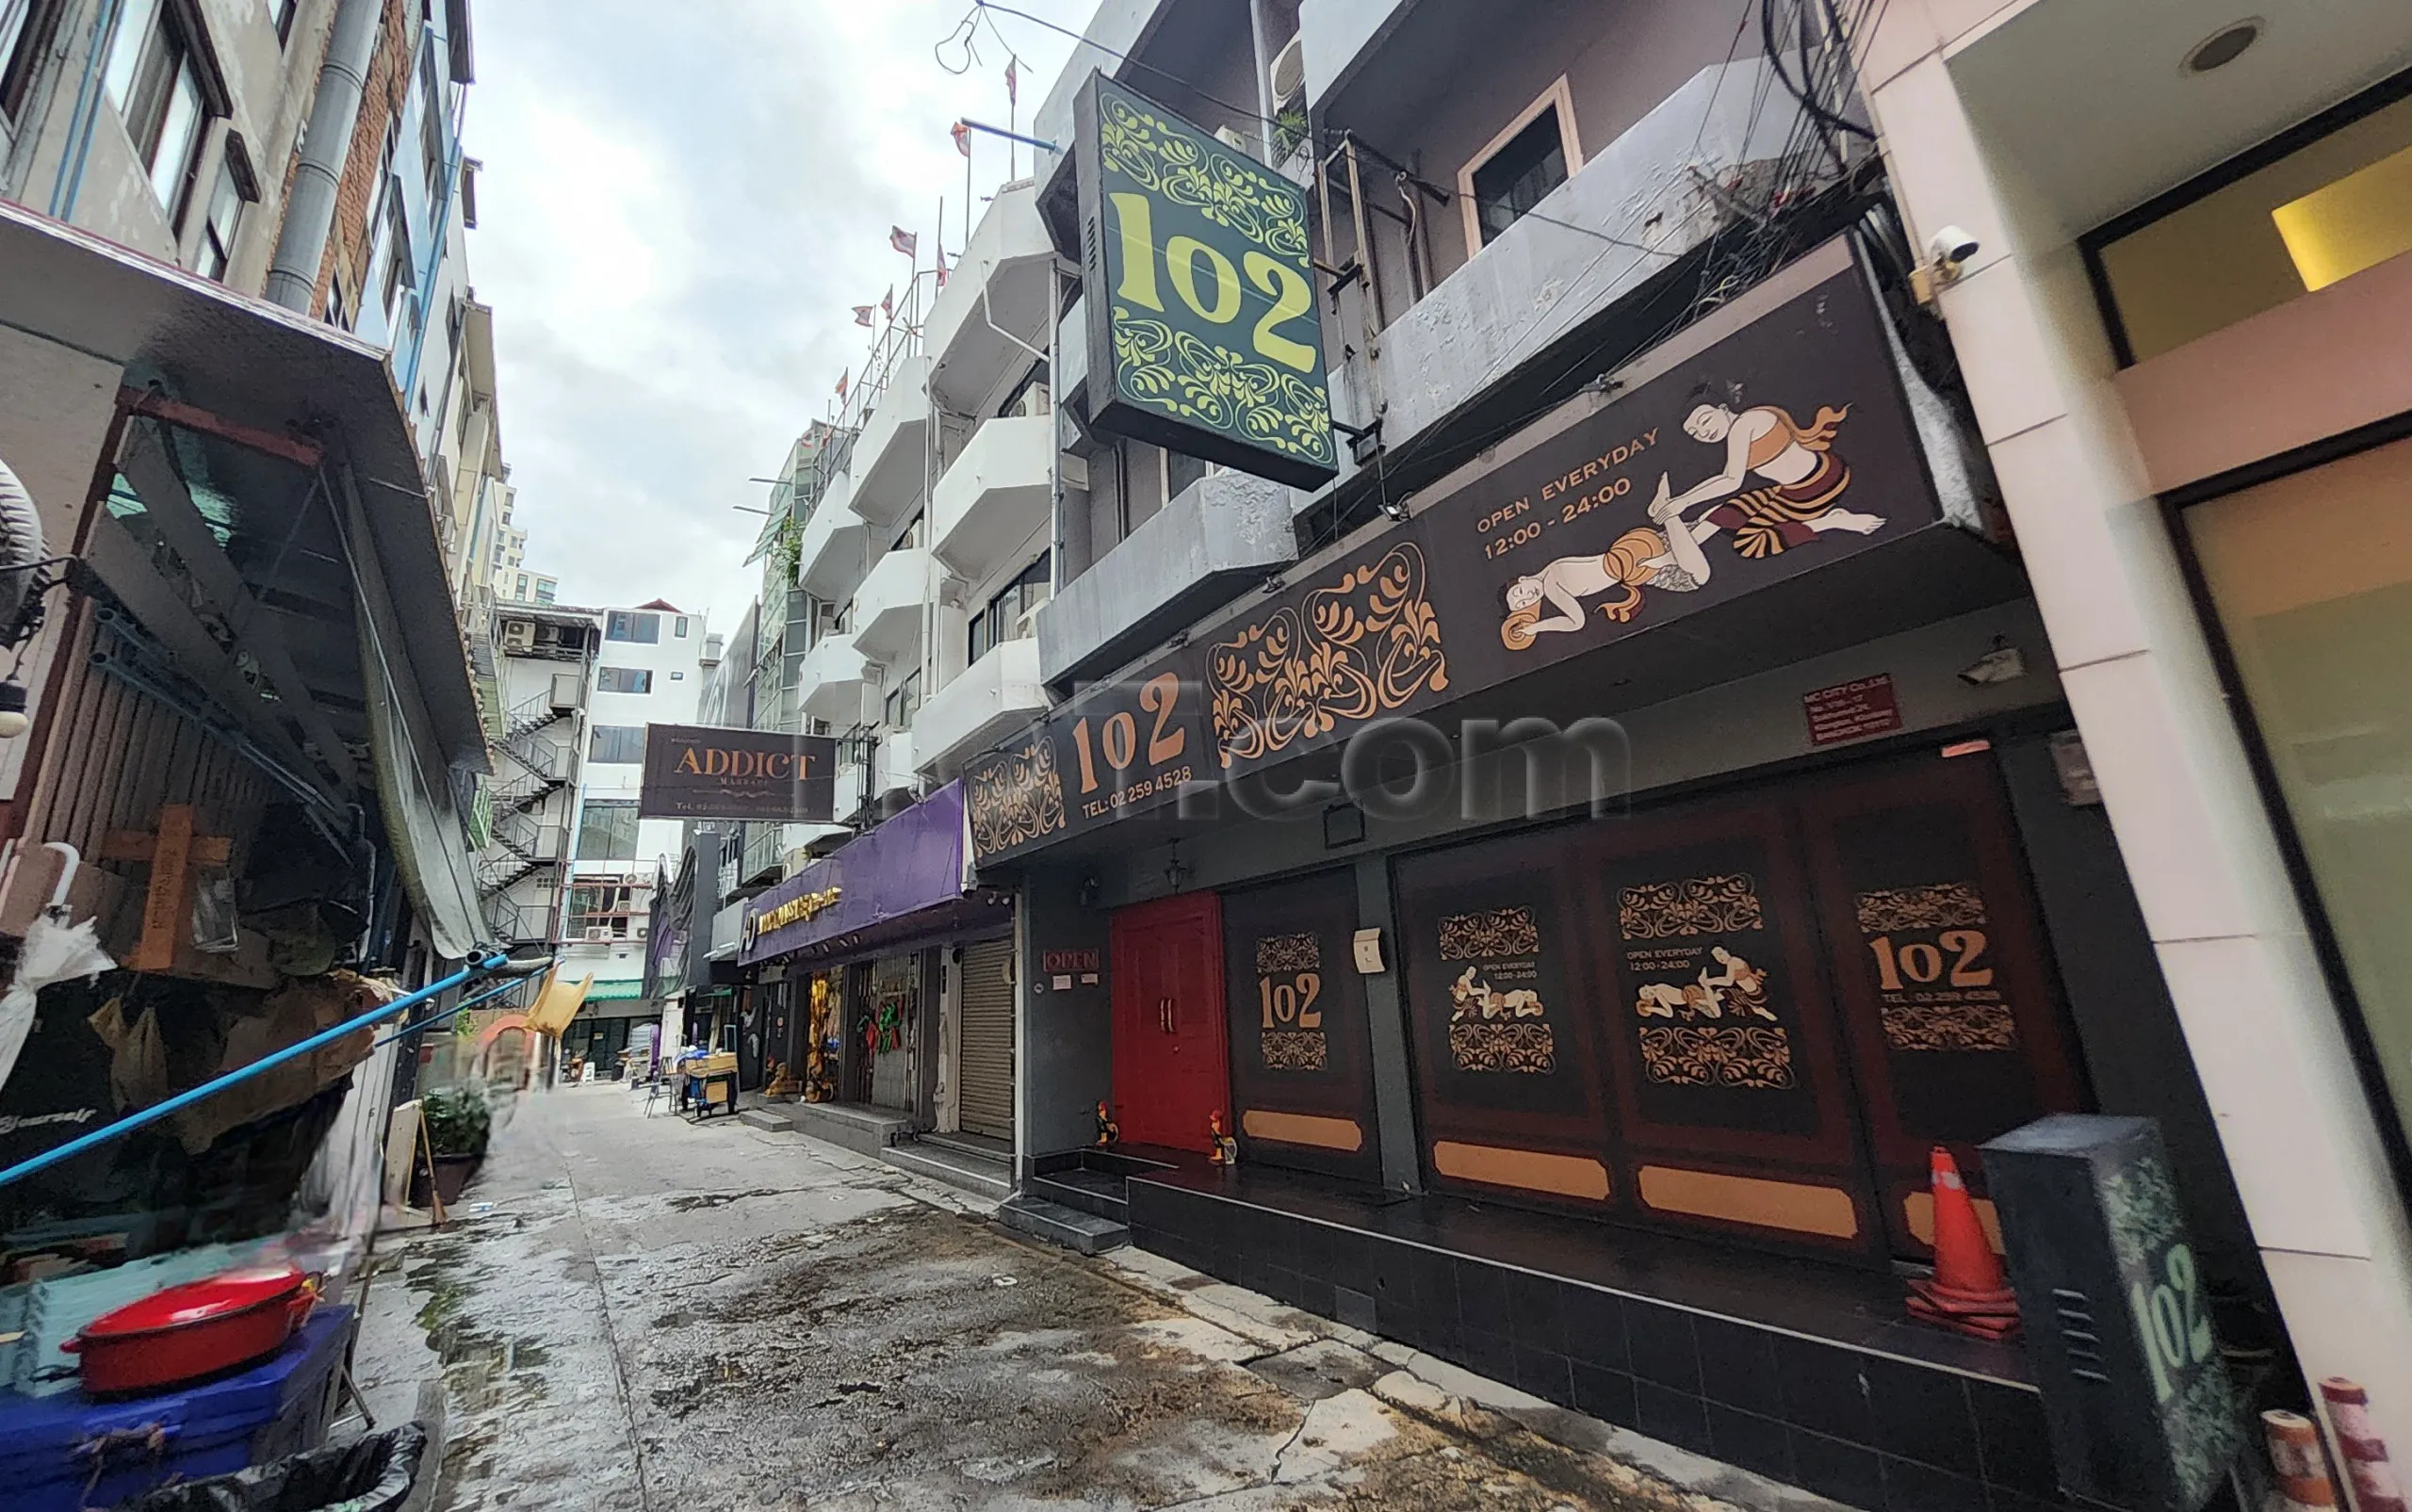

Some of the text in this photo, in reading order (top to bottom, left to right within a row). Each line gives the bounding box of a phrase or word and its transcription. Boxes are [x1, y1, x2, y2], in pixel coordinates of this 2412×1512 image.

[1109, 192, 1317, 373] 102
[1475, 427, 1659, 533] OPEN EVERYDAY
[1485, 522, 1541, 561] 12:00
[1561, 477, 1632, 524] 24:00
[1072, 671, 1185, 794] 102
[674, 746, 817, 781] ADDICT
[1083, 766, 1192, 820] TEL: 02 259 4528
[1047, 951, 1097, 969] OPEN
[1627, 946, 1703, 960] OPEN EVERYDAY
[1869, 930, 1994, 990] 102
[1259, 973, 1322, 1029] 102
[2129, 1243, 2214, 1405] 102
